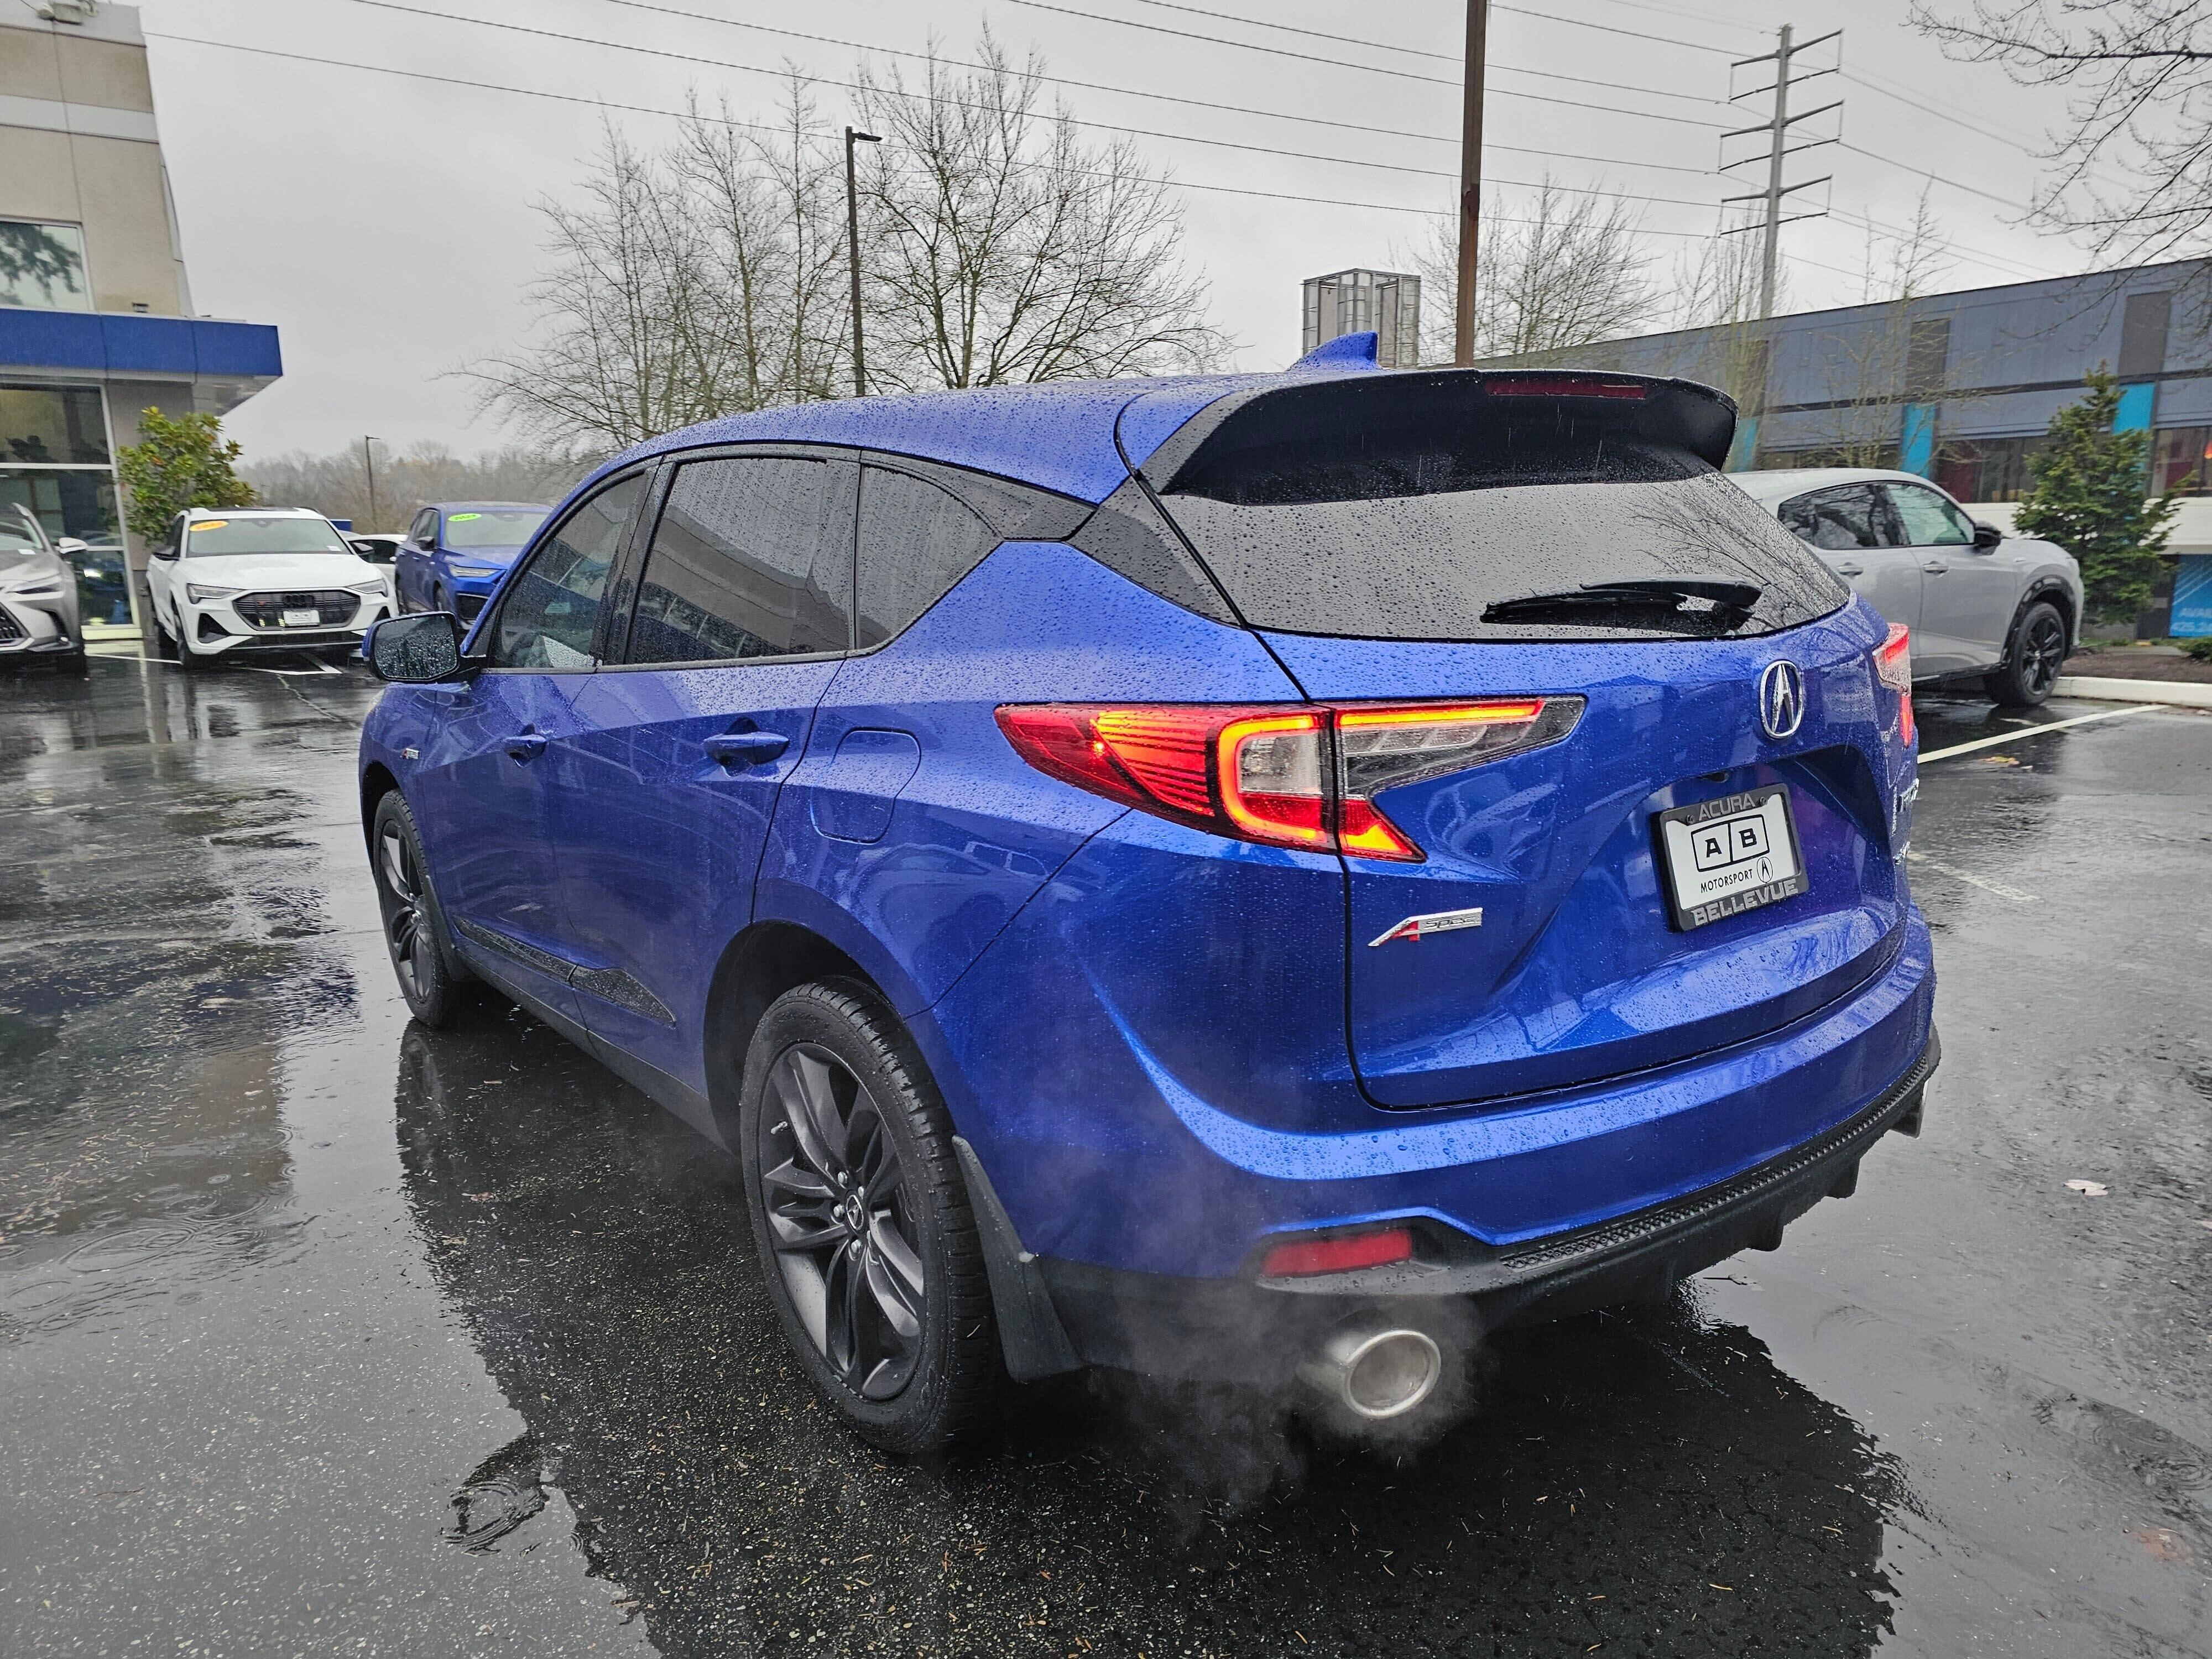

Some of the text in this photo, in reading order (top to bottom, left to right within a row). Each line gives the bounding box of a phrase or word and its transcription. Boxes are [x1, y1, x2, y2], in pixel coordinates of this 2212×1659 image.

[1699, 793, 1755, 821] ACURA
[1700, 869, 1752, 894] MOTORSPORT
[1691, 878, 1798, 926] BELLEVUE
